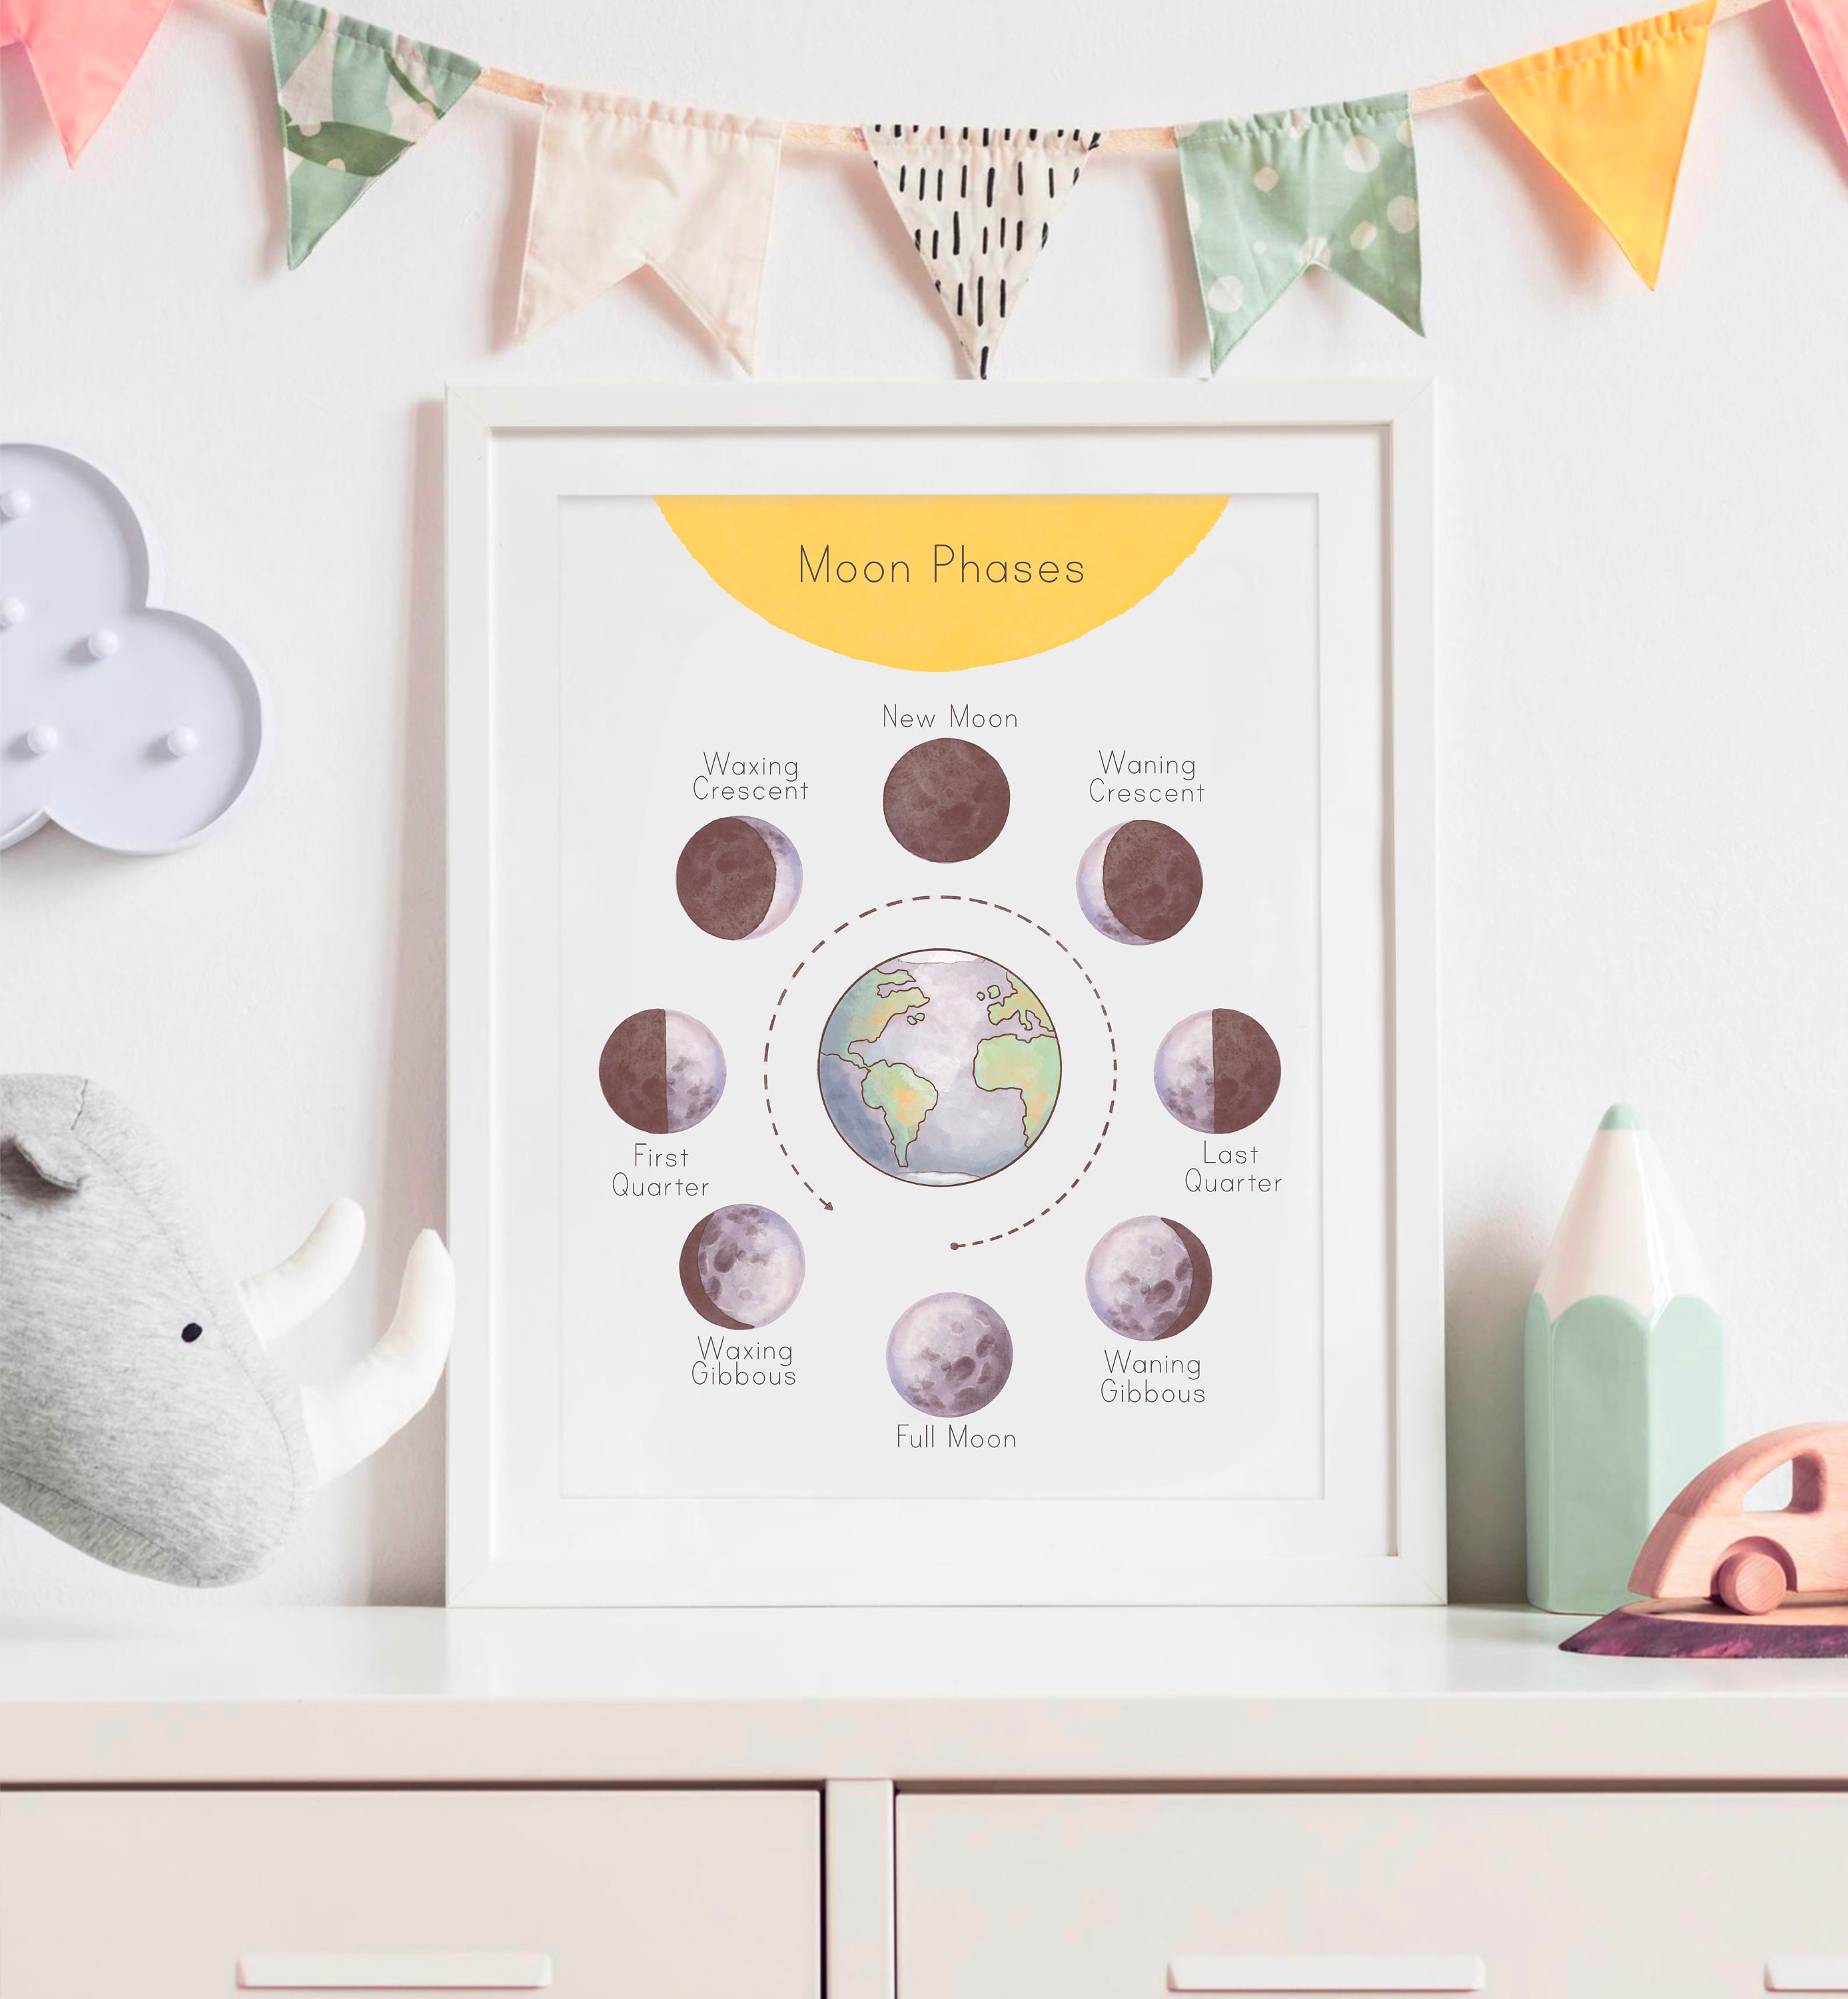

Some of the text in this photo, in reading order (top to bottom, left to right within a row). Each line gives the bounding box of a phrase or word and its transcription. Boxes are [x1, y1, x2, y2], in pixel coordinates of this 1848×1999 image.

[800, 544, 1084, 584] Moon Phases
[883, 703, 1017, 728] New Moon
[703, 751, 798, 782] Waxing
[1099, 750, 1195, 781] Waning
[693, 775, 809, 800] Crescent
[1089, 778, 1205, 803] Crescent
[635, 1143, 689, 1167] First
[1204, 1139, 1258, 1165] Last
[612, 1171, 709, 1197] Quarter
[1184, 1167, 1282, 1193] Quarter
[697, 1335, 792, 1367] Waxing
[692, 1360, 796, 1385] Gibbous
[1104, 1349, 1200, 1381] Waning
[1101, 1378, 1205, 1403] Gibbous
[897, 1424, 1016, 1449] Full Moon
